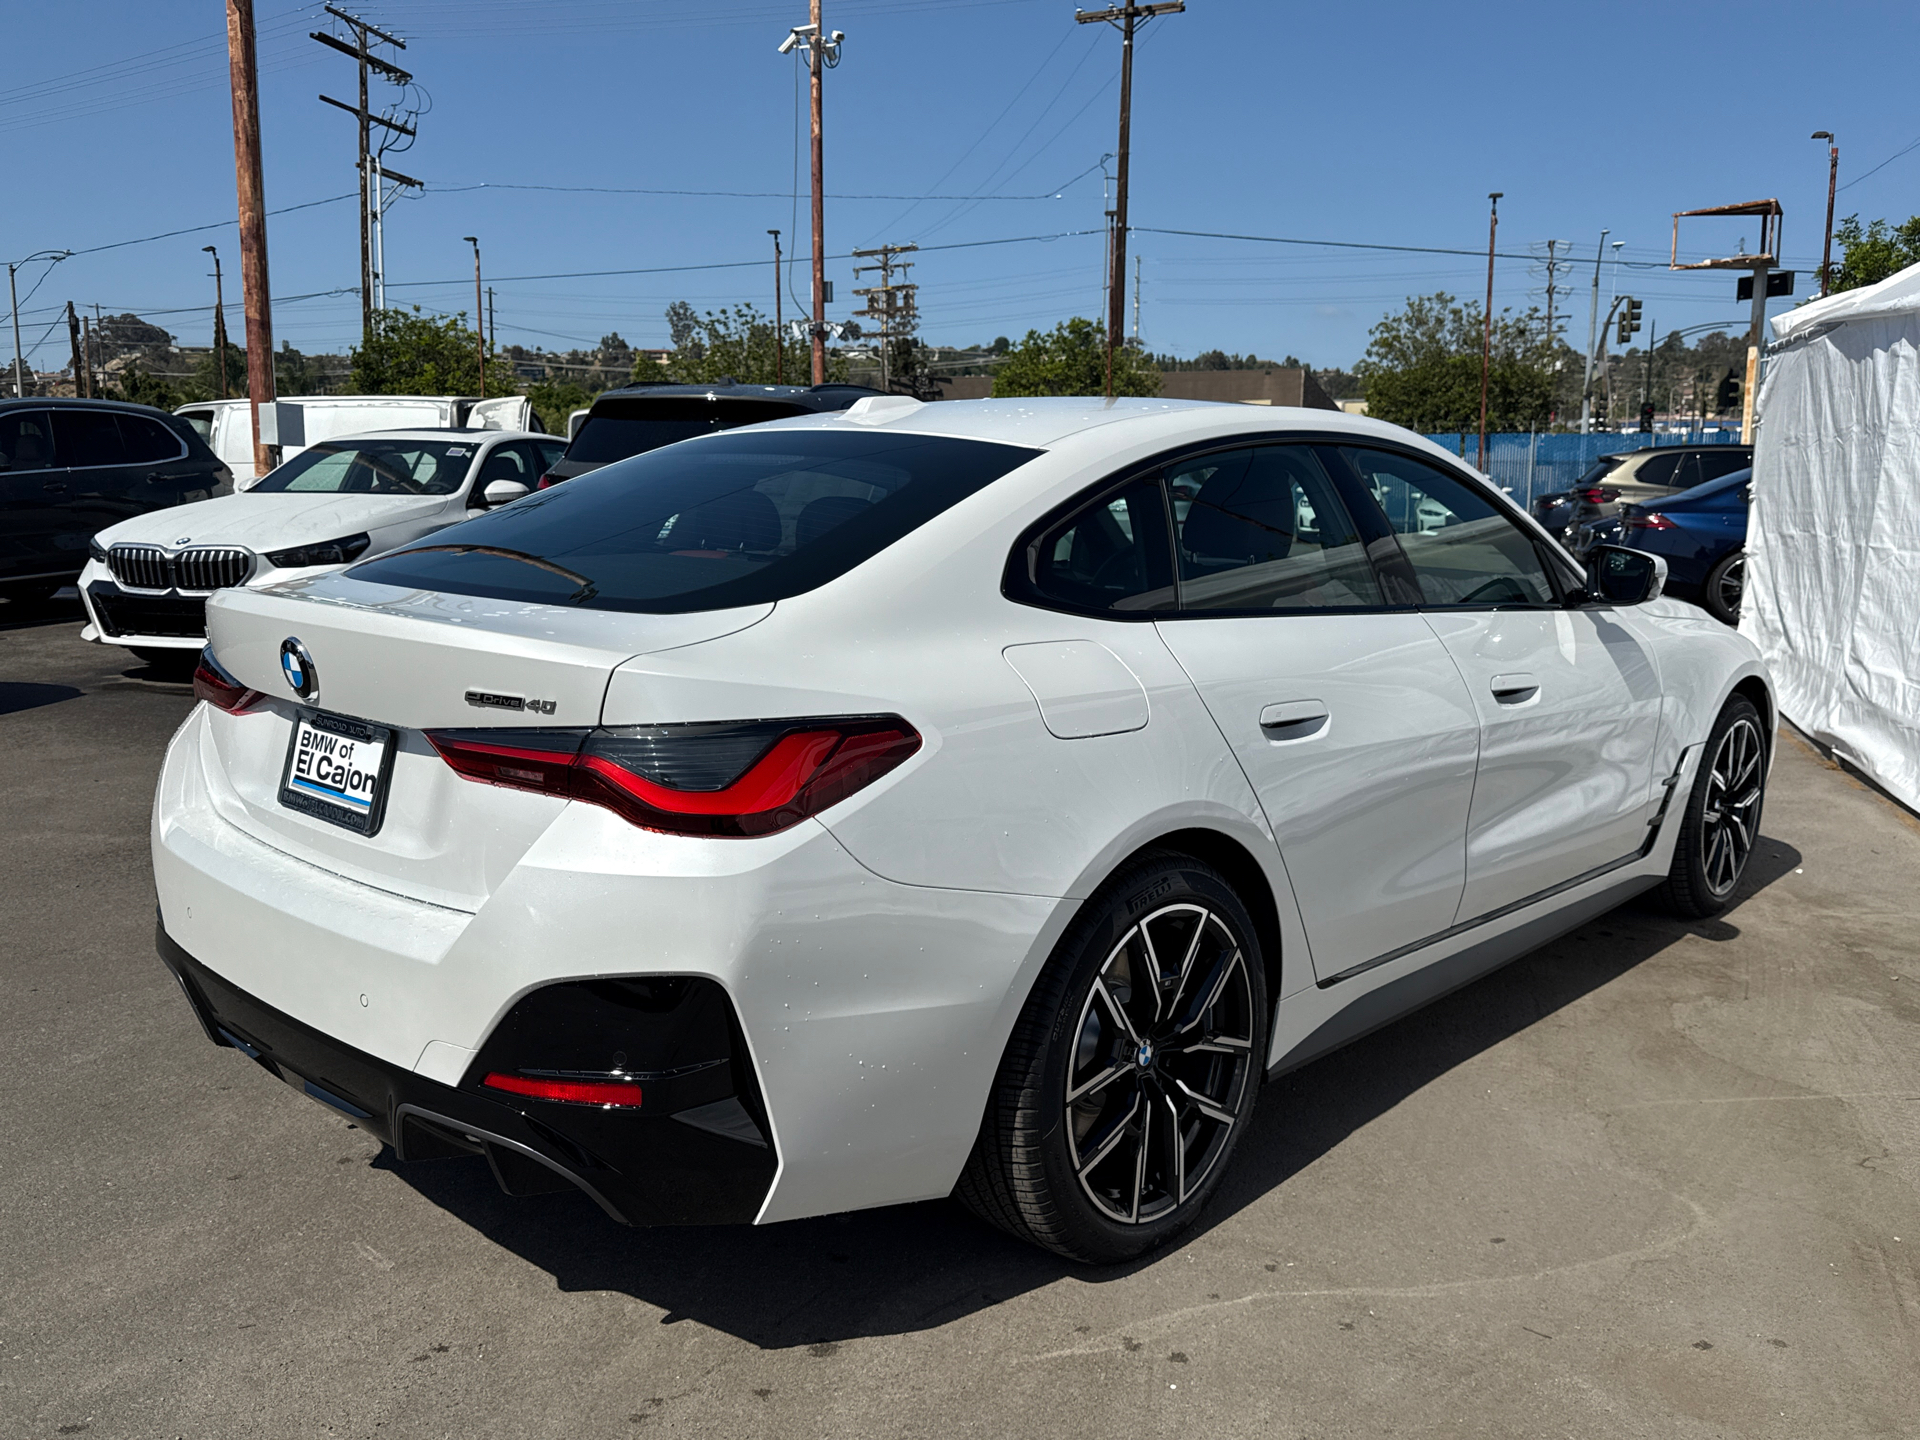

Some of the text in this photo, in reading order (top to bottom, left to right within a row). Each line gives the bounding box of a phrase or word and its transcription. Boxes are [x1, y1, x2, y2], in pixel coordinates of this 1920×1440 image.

[300, 730, 355, 760] BMW of
[296, 750, 376, 794] El Cajon
[1125, 876, 1172, 915] PIRELLI
